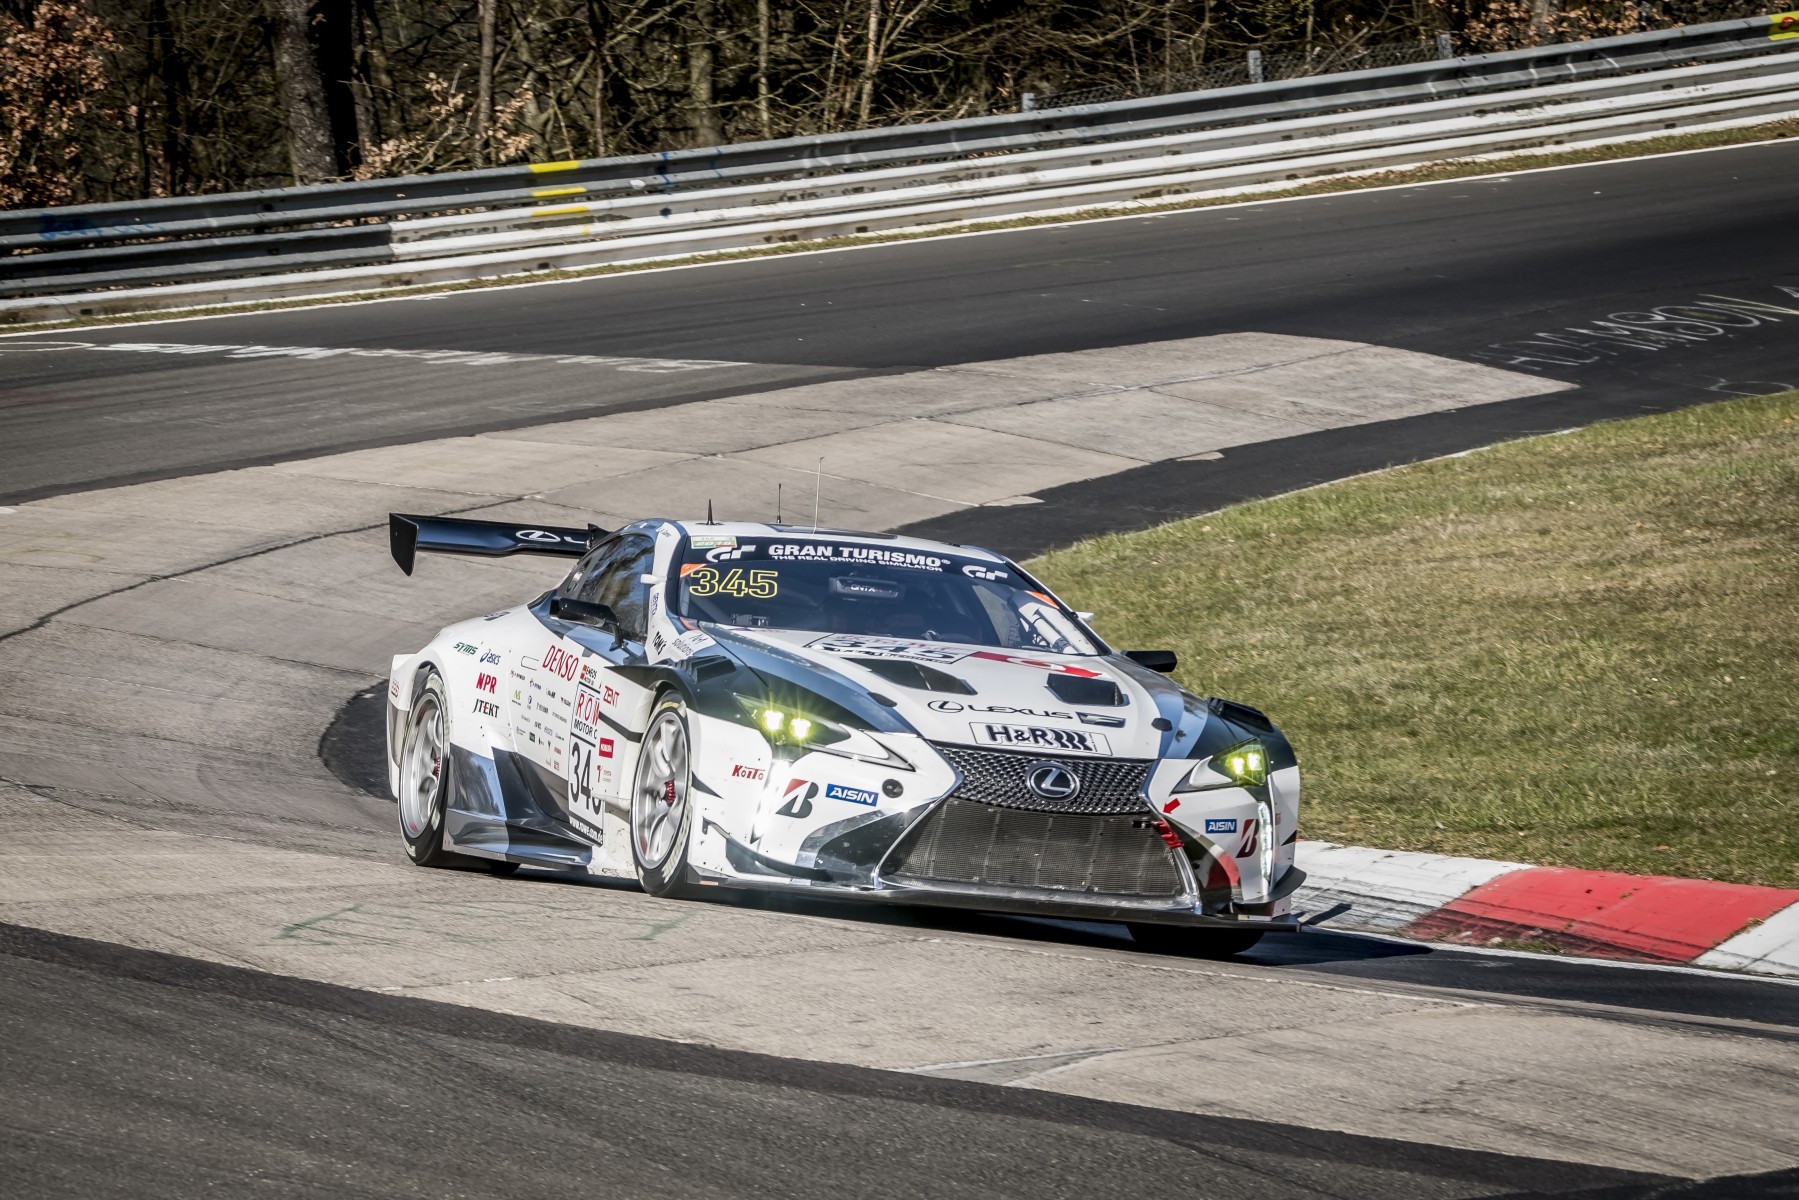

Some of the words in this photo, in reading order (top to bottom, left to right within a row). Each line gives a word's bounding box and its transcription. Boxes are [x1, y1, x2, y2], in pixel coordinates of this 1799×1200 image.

[768, 544, 833, 557] GRAN
[830, 557, 876, 565] DRIVING
[878, 560, 943, 572] SIMULATOR
[689, 567, 779, 599] 345
[542, 644, 579, 682] DENSO
[476, 672, 497, 694] NPR
[603, 685, 620, 708] ZENT
[472, 699, 499, 718] JTEKT
[968, 704, 1074, 720] LEXUS
[574, 718, 593, 738] MOTOR
[985, 722, 1049, 747] H&R
[829, 786, 876, 804] AISIN
[1207, 821, 1236, 832] AISIN
